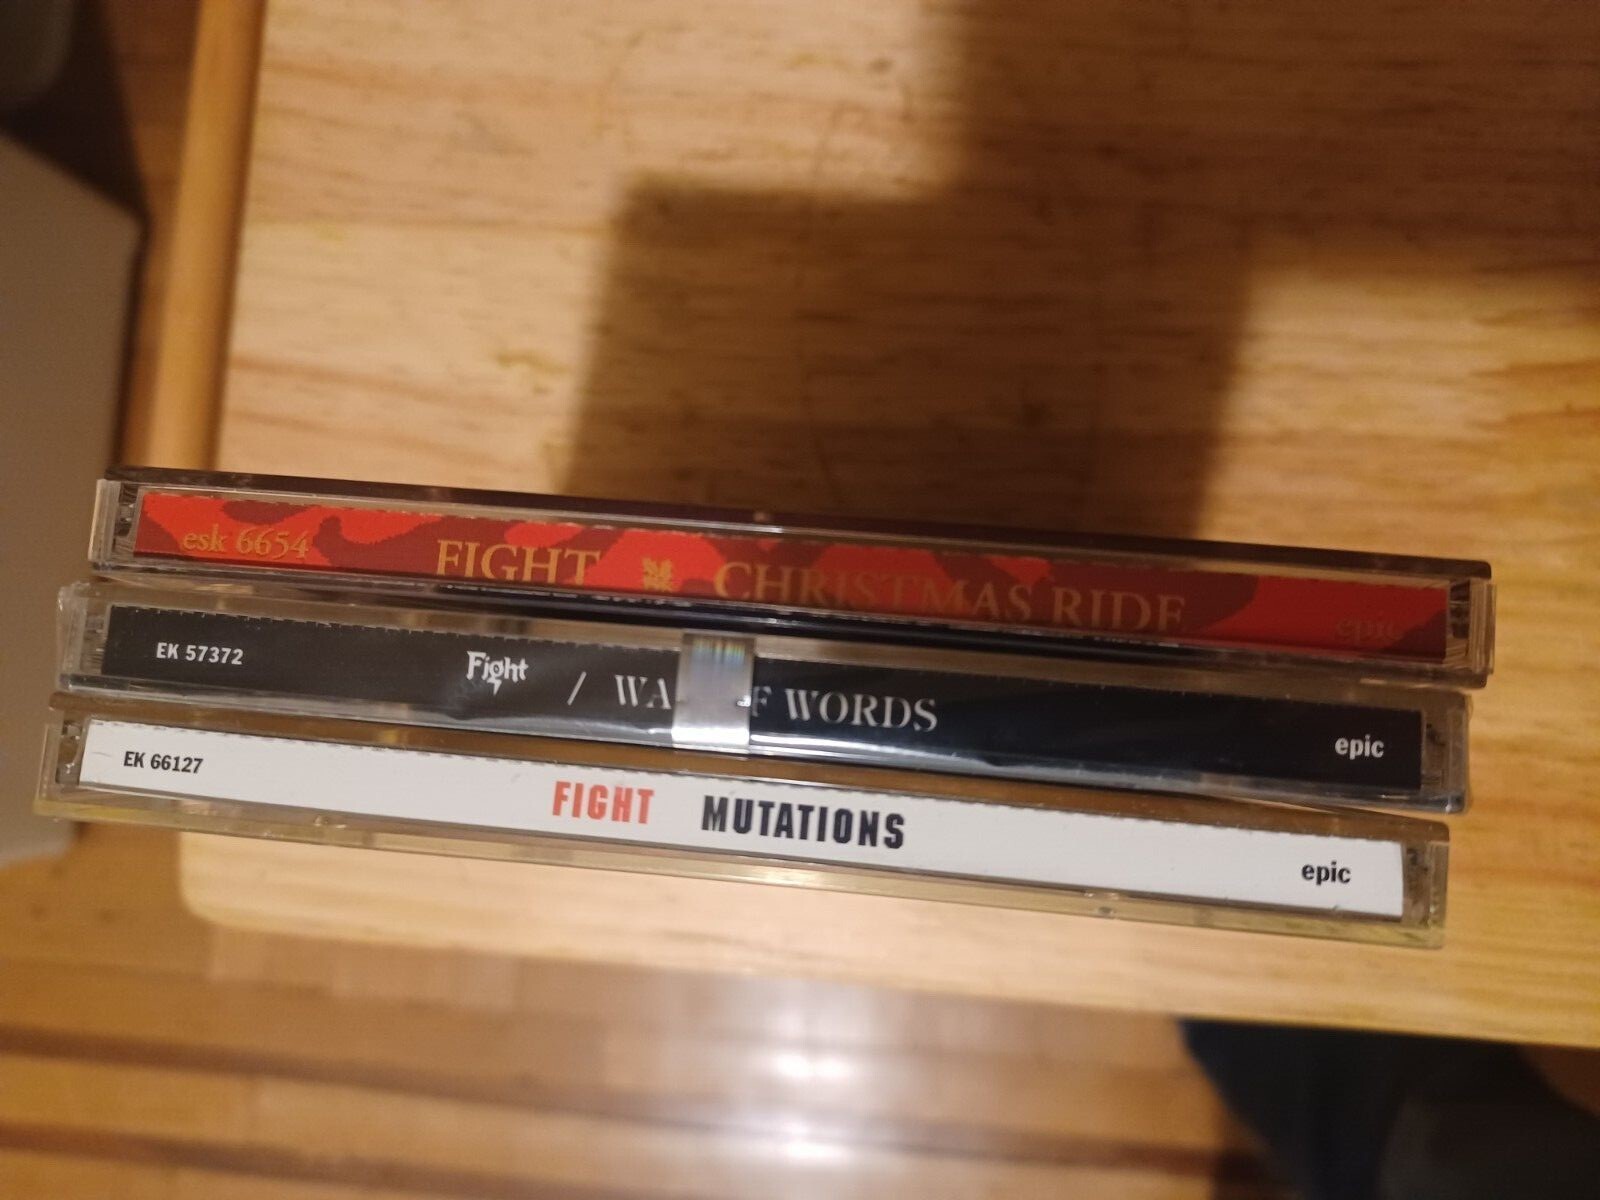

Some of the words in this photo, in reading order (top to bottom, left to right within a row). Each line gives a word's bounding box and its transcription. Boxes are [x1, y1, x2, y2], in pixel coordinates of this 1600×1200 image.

[183, 523, 227, 552] esk
[236, 527, 309, 559] 6654
[436, 539, 600, 584] FIGHT
[713, 561, 1034, 622] CHRISTMAS
[157, 642, 179, 660] EK
[185, 644, 244, 665] 57372
[465, 650, 530, 693] Fight
[615, 674, 677, 710] WA
[785, 688, 938, 732] WORDS
[124, 751, 145, 769] EK
[151, 754, 204, 774] 66127
[1335, 735, 1384, 760] epic
[552, 781, 654, 824] FIGHT
[701, 795, 906, 849] MUTATIONS
[1302, 860, 1352, 886] epic
